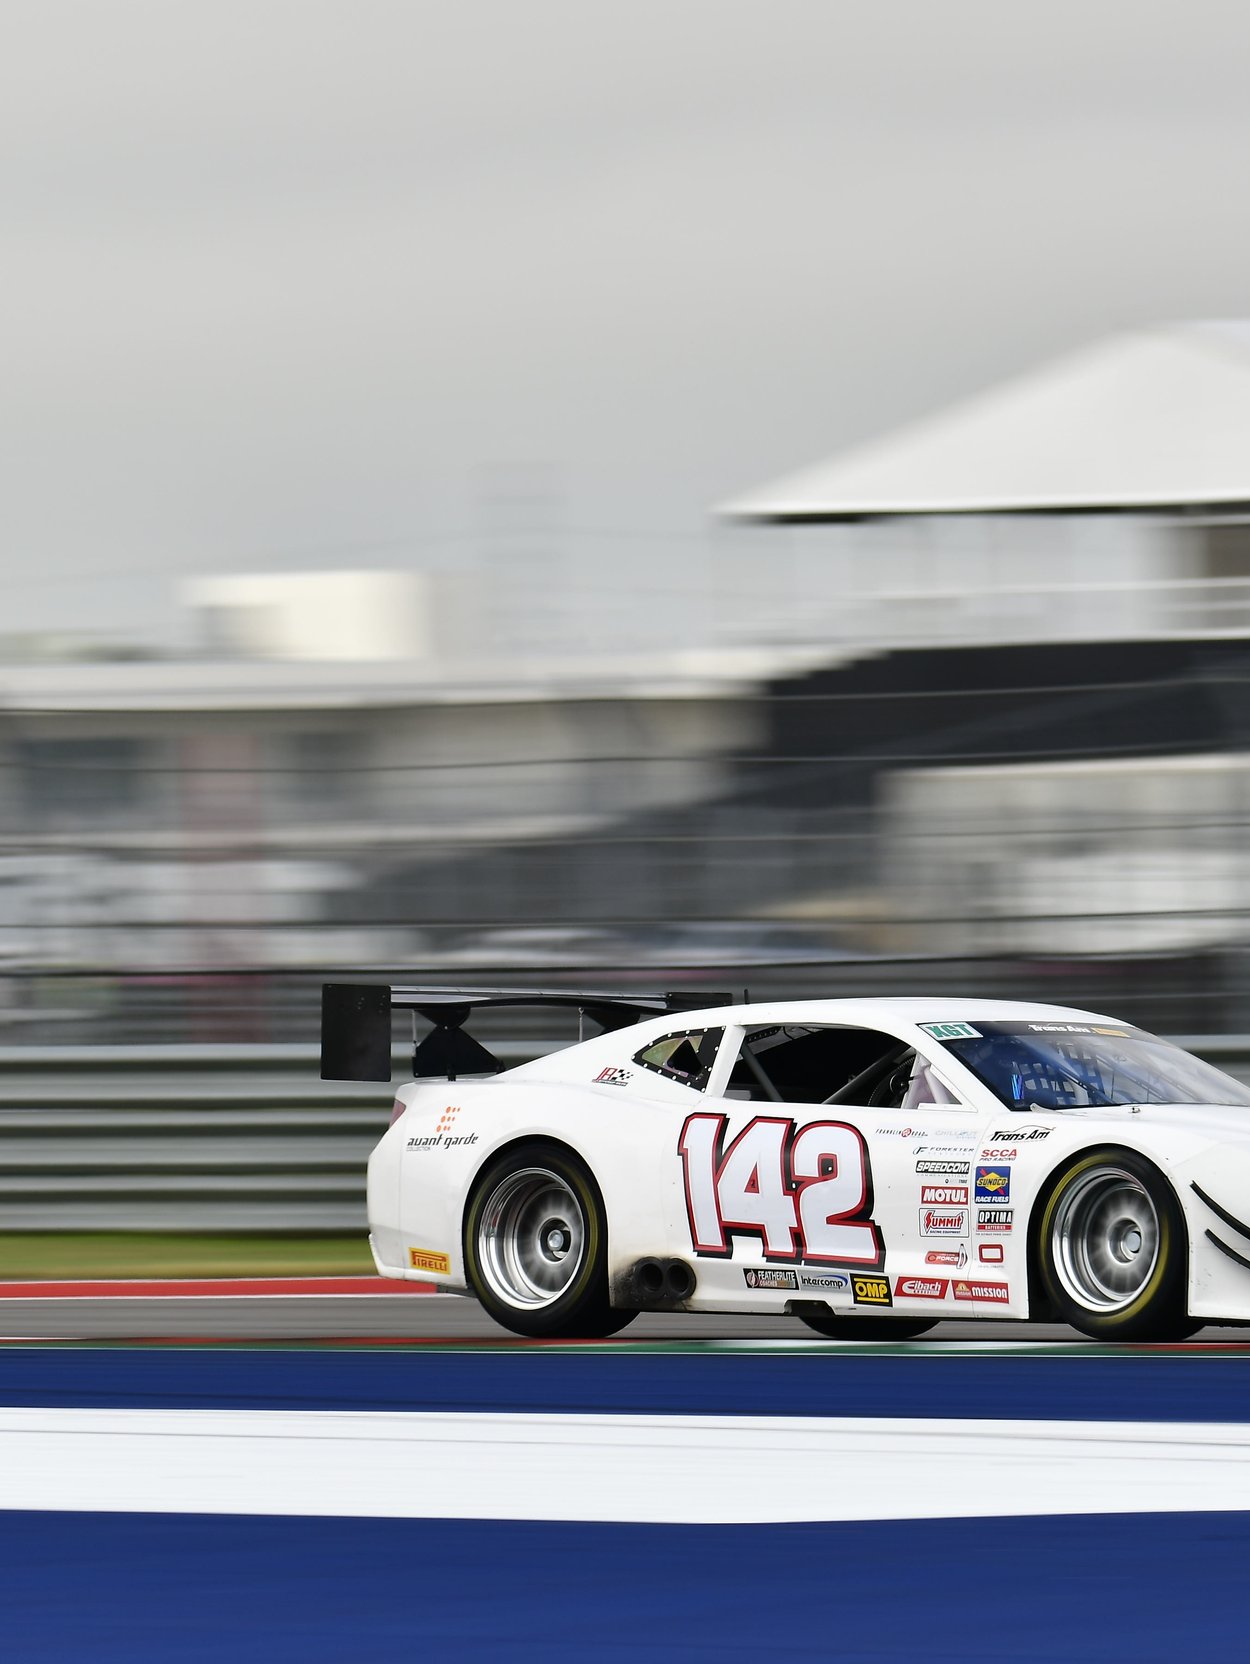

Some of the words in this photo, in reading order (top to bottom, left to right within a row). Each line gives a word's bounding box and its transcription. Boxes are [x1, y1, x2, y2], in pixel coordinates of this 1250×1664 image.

[925, 1022, 975, 1038] XGT
[444, 1132, 479, 1149] garde
[990, 1131, 1027, 1141] Trans
[1026, 1129, 1050, 1140] Am
[980, 1148, 1017, 1158] SCCA
[977, 1178, 1008, 1186] SUNOCO
[678, 1112, 886, 1272] 142
[923, 1187, 967, 1203] MOTUL
[992, 1195, 1009, 1203] FUELS
[979, 1211, 1013, 1223] OPTIMA
[411, 1250, 448, 1271] PIRELLI
[758, 1270, 796, 1281] FEATHERLITE
[801, 1275, 843, 1289] Intercomp
[855, 1283, 888, 1298] OMP
[902, 1280, 941, 1296] Eibach
